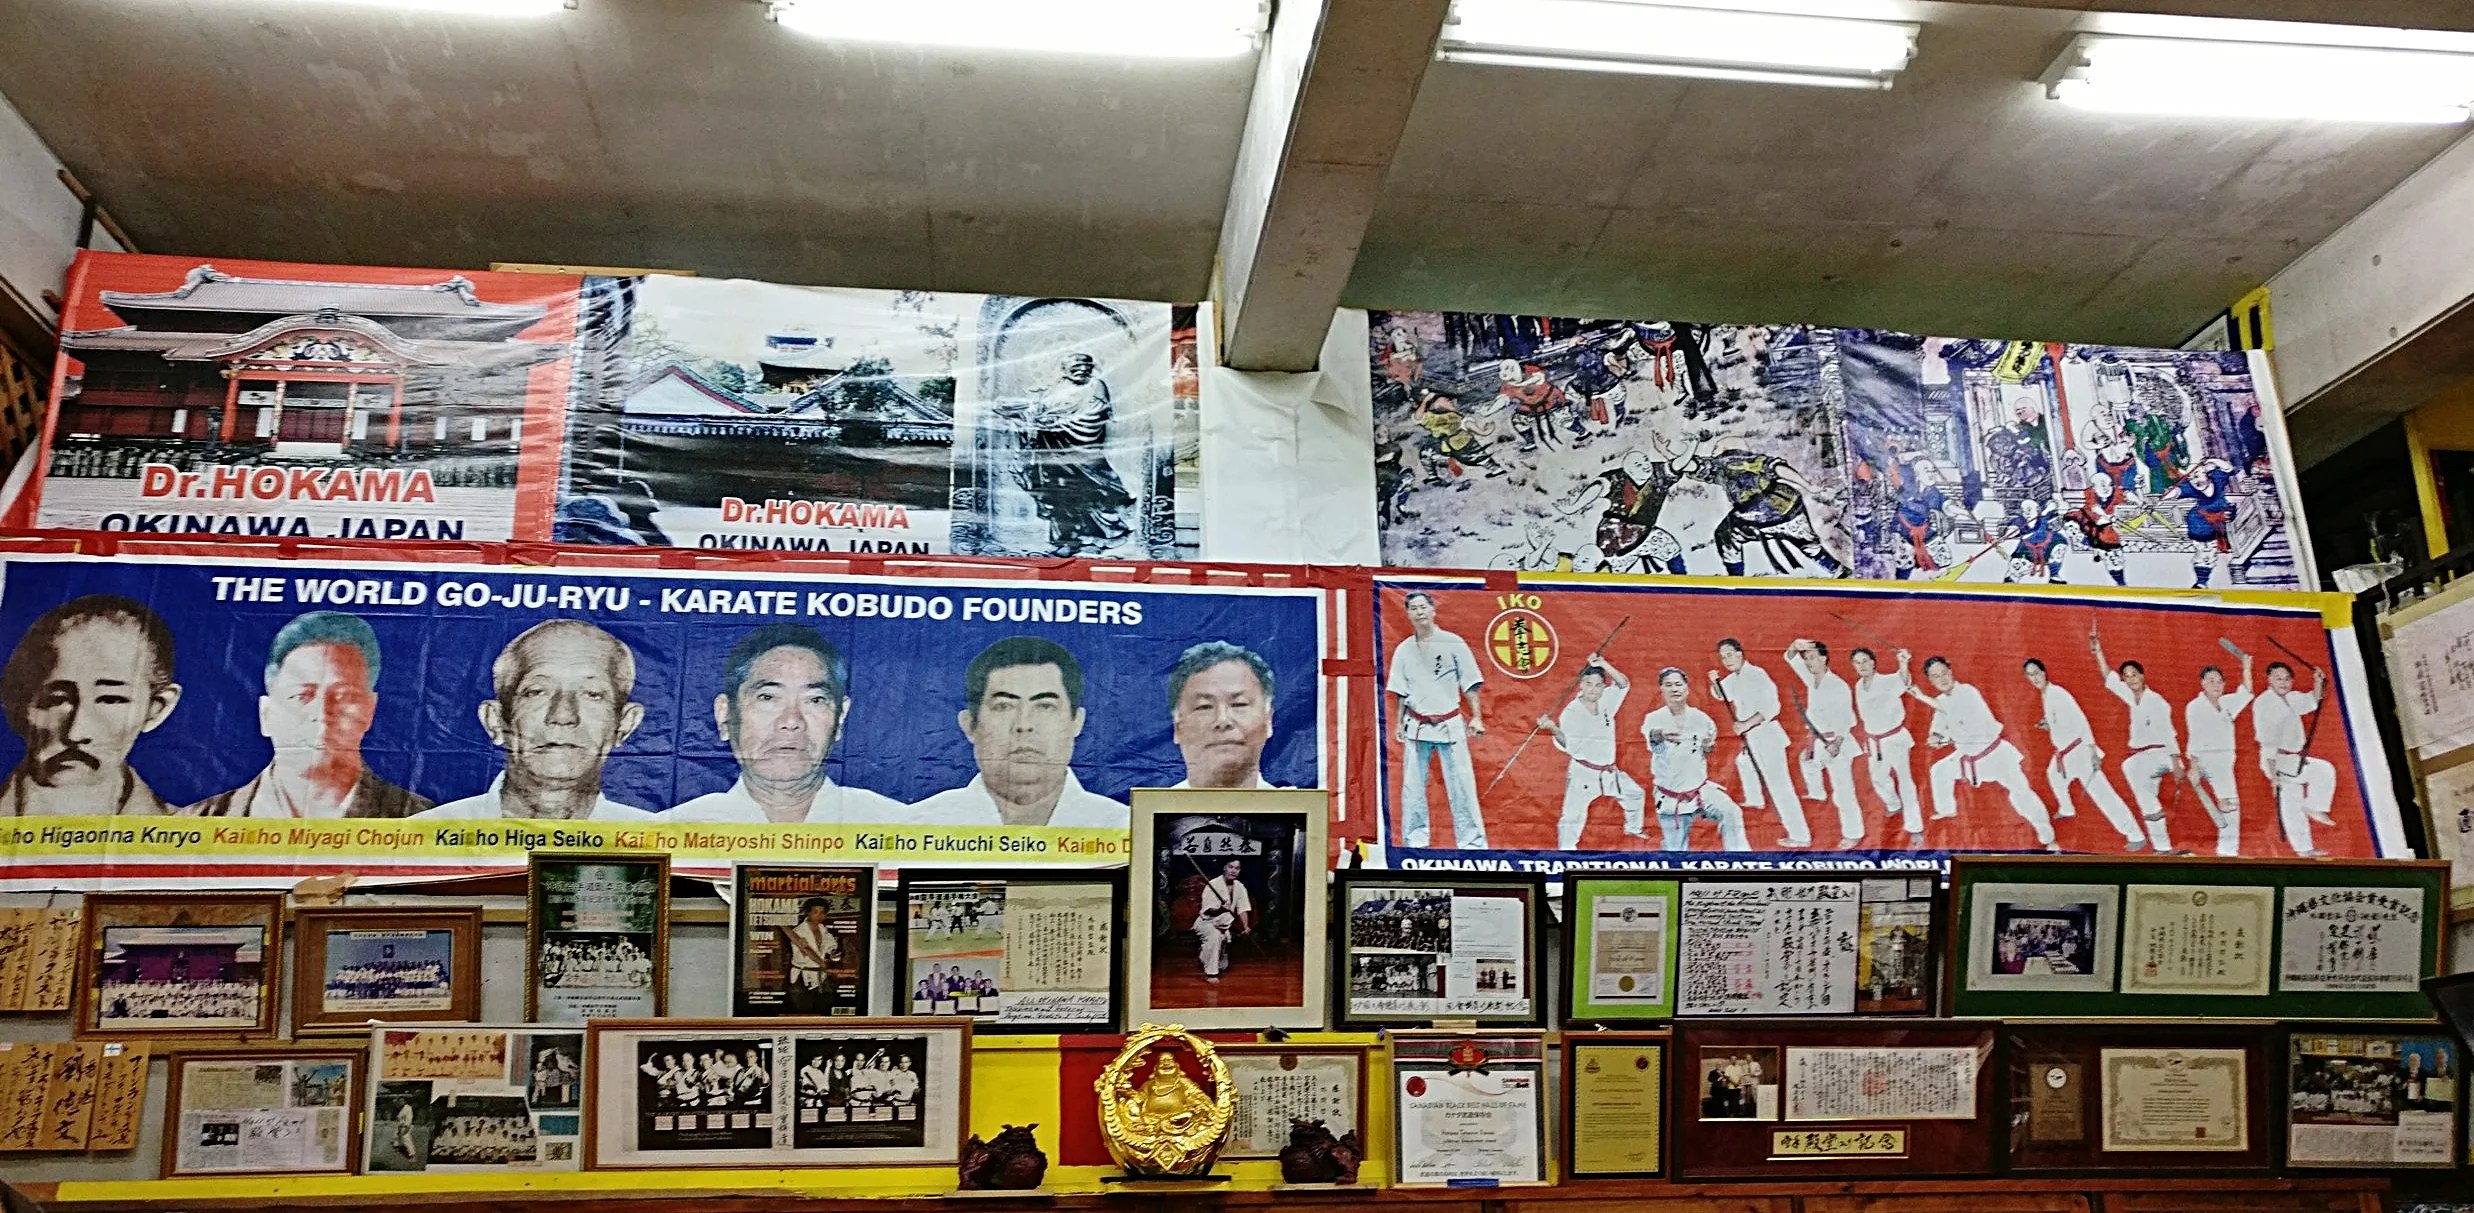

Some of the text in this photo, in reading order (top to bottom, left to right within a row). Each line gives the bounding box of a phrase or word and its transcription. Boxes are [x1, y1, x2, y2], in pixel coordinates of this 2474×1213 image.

[142, 465, 435, 504] Dr.HOKAMA
[721, 497, 910, 530] Dr.HOKAMA
[212, 576, 284, 602] THE
[296, 578, 427, 608] WORLD
[436, 583, 629, 611] GO-JU-RYU
[660, 587, 797, 616] KARATE
[806, 593, 953, 620] KOBUDO
[963, 597, 1143, 625] FOUNDERS
[1497, 593, 1542, 610] IKO
[41, 827, 134, 848] Higaonna
[142, 826, 201, 849] Knryo
[288, 829, 351, 850] Miyagi
[356, 829, 424, 853] Chojun
[505, 831, 547, 851] Higa
[553, 829, 603, 849] Seiko
[683, 832, 776, 854] Matayoshi
[782, 833, 844, 855] Shinpo
[923, 835, 994, 852] Fukuchi
[999, 836, 1047, 852] Seiko
[1881, 859, 1951, 875] WORL
[750, 874, 815, 892] martial
